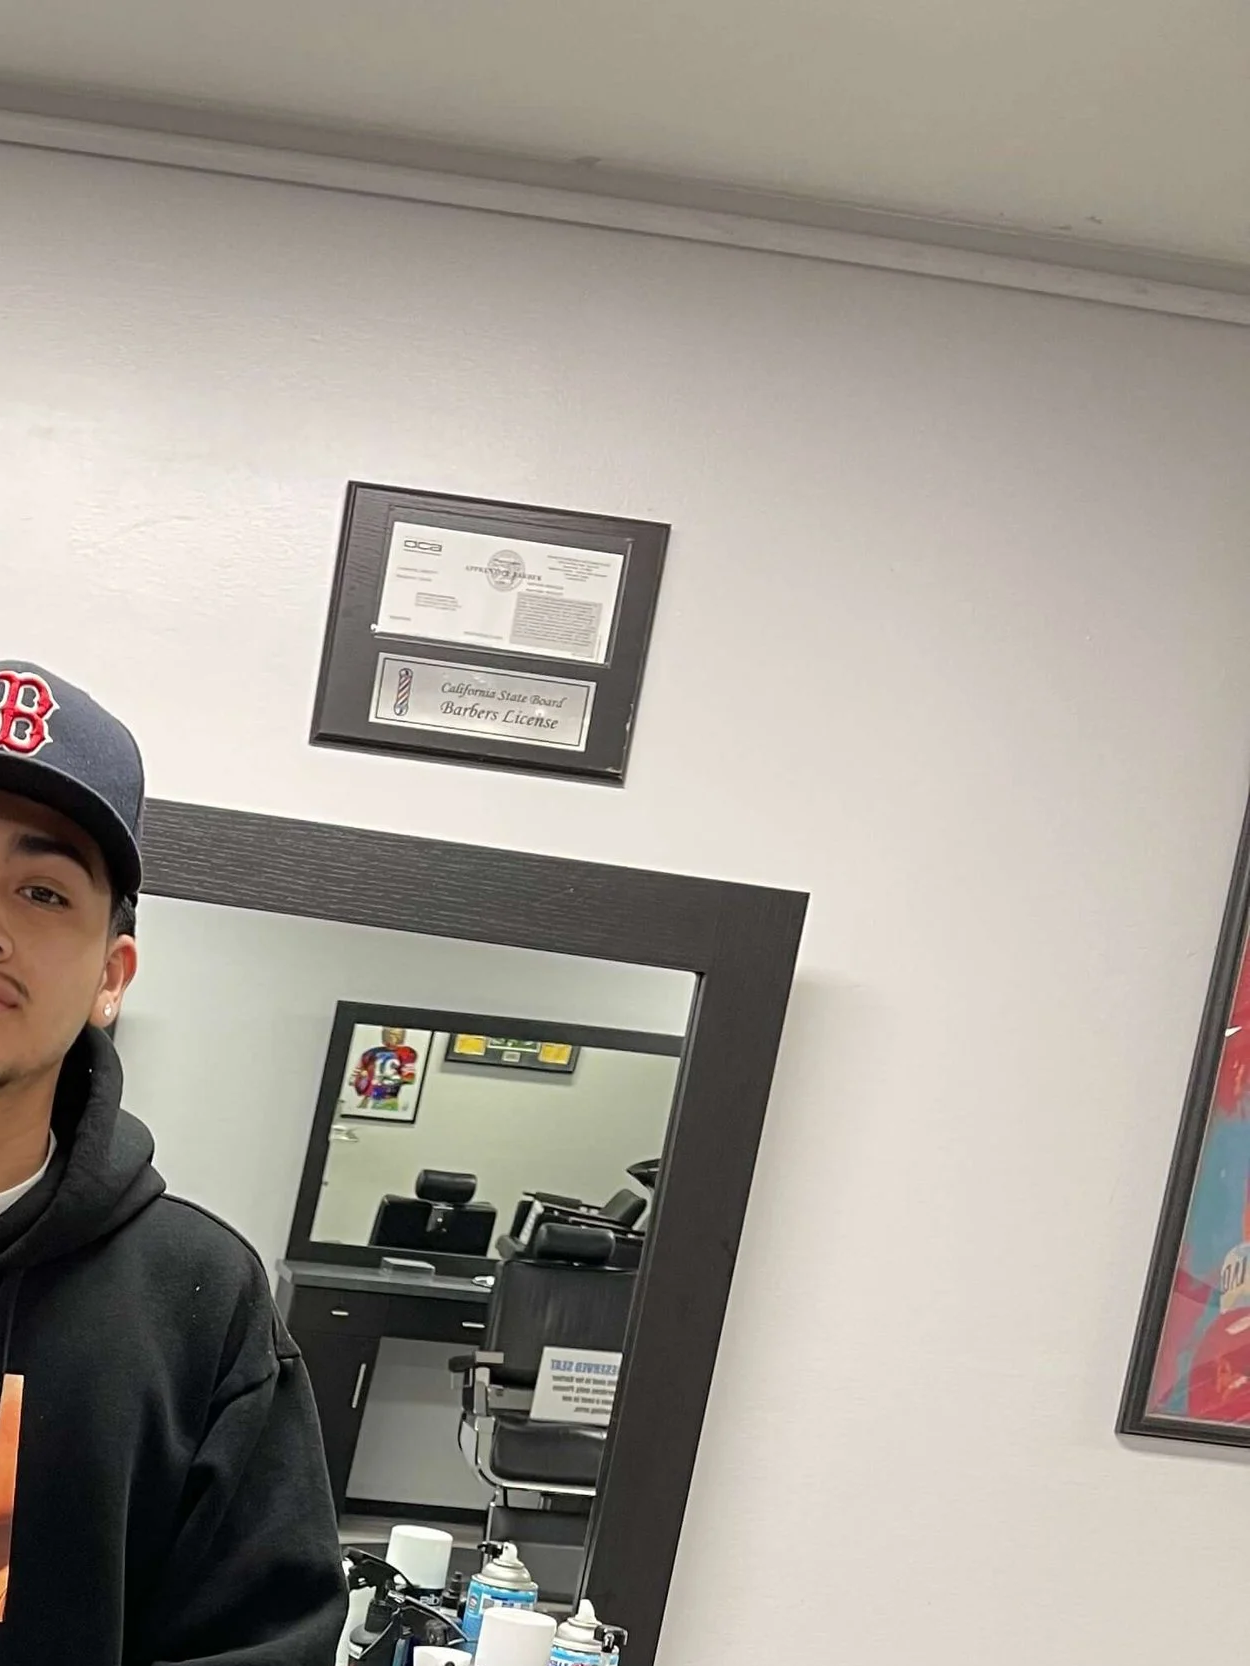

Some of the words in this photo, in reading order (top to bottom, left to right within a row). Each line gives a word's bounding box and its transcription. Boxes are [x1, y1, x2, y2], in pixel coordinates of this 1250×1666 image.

[441, 682, 496, 699] California
[498, 690, 528, 703] State
[529, 695, 567, 708] Board
[440, 701, 499, 721] Barbers
[502, 709, 559, 729] License
